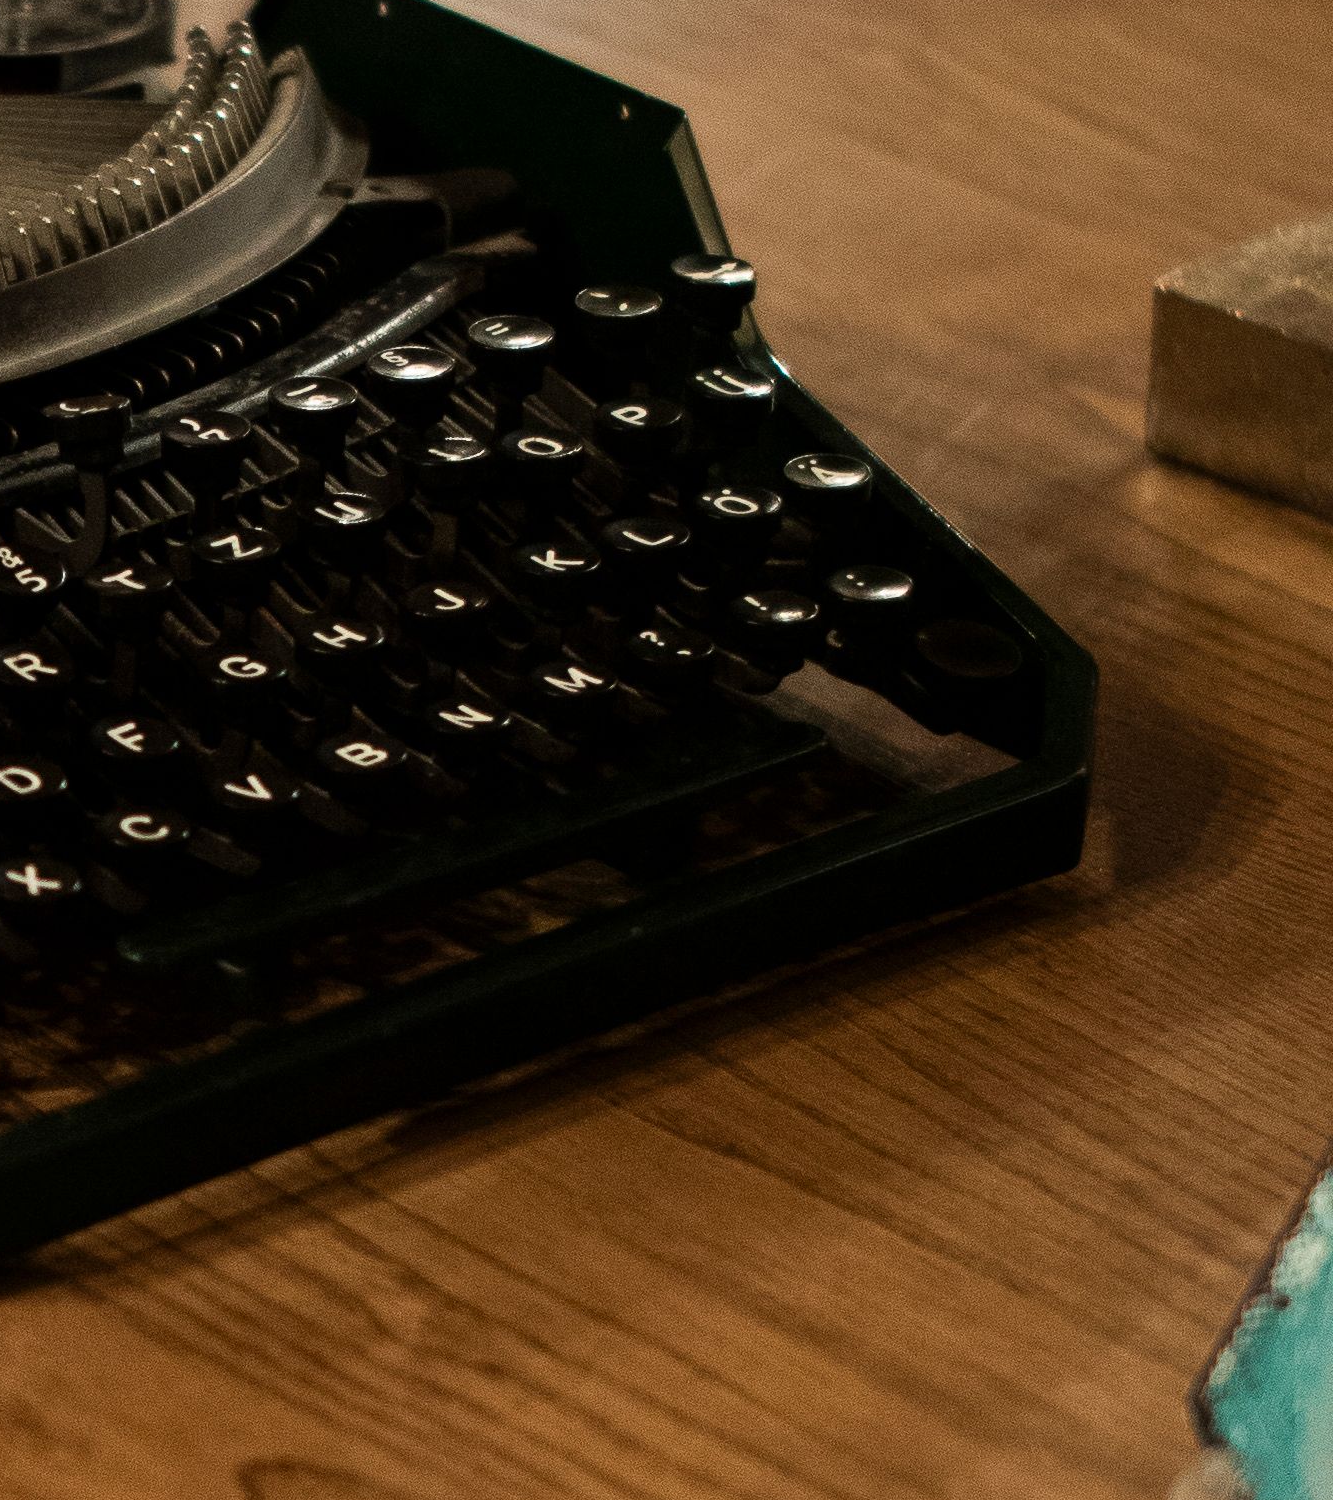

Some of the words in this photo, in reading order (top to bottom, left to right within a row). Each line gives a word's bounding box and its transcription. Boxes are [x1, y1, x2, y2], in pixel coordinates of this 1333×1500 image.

[2, 651, 60, 683] R
[101, 567, 147, 592] T
[209, 534, 264, 559] Z
[517, 435, 564, 457] O
[608, 404, 649, 428] P
[14, 567, 49, 594] 5
[105, 720, 147, 754] F
[217, 654, 270, 680] G
[310, 622, 370, 650] H
[431, 586, 467, 612] J
[528, 548, 587, 573] K
[620, 528, 676, 548] L
[700, 487, 761, 516] Ö
[4, 862, 64, 897] X
[118, 812, 172, 843] C
[222, 772, 275, 802] V
[333, 741, 391, 769] B
[437, 702, 497, 730] N
[542, 665, 605, 695] M
